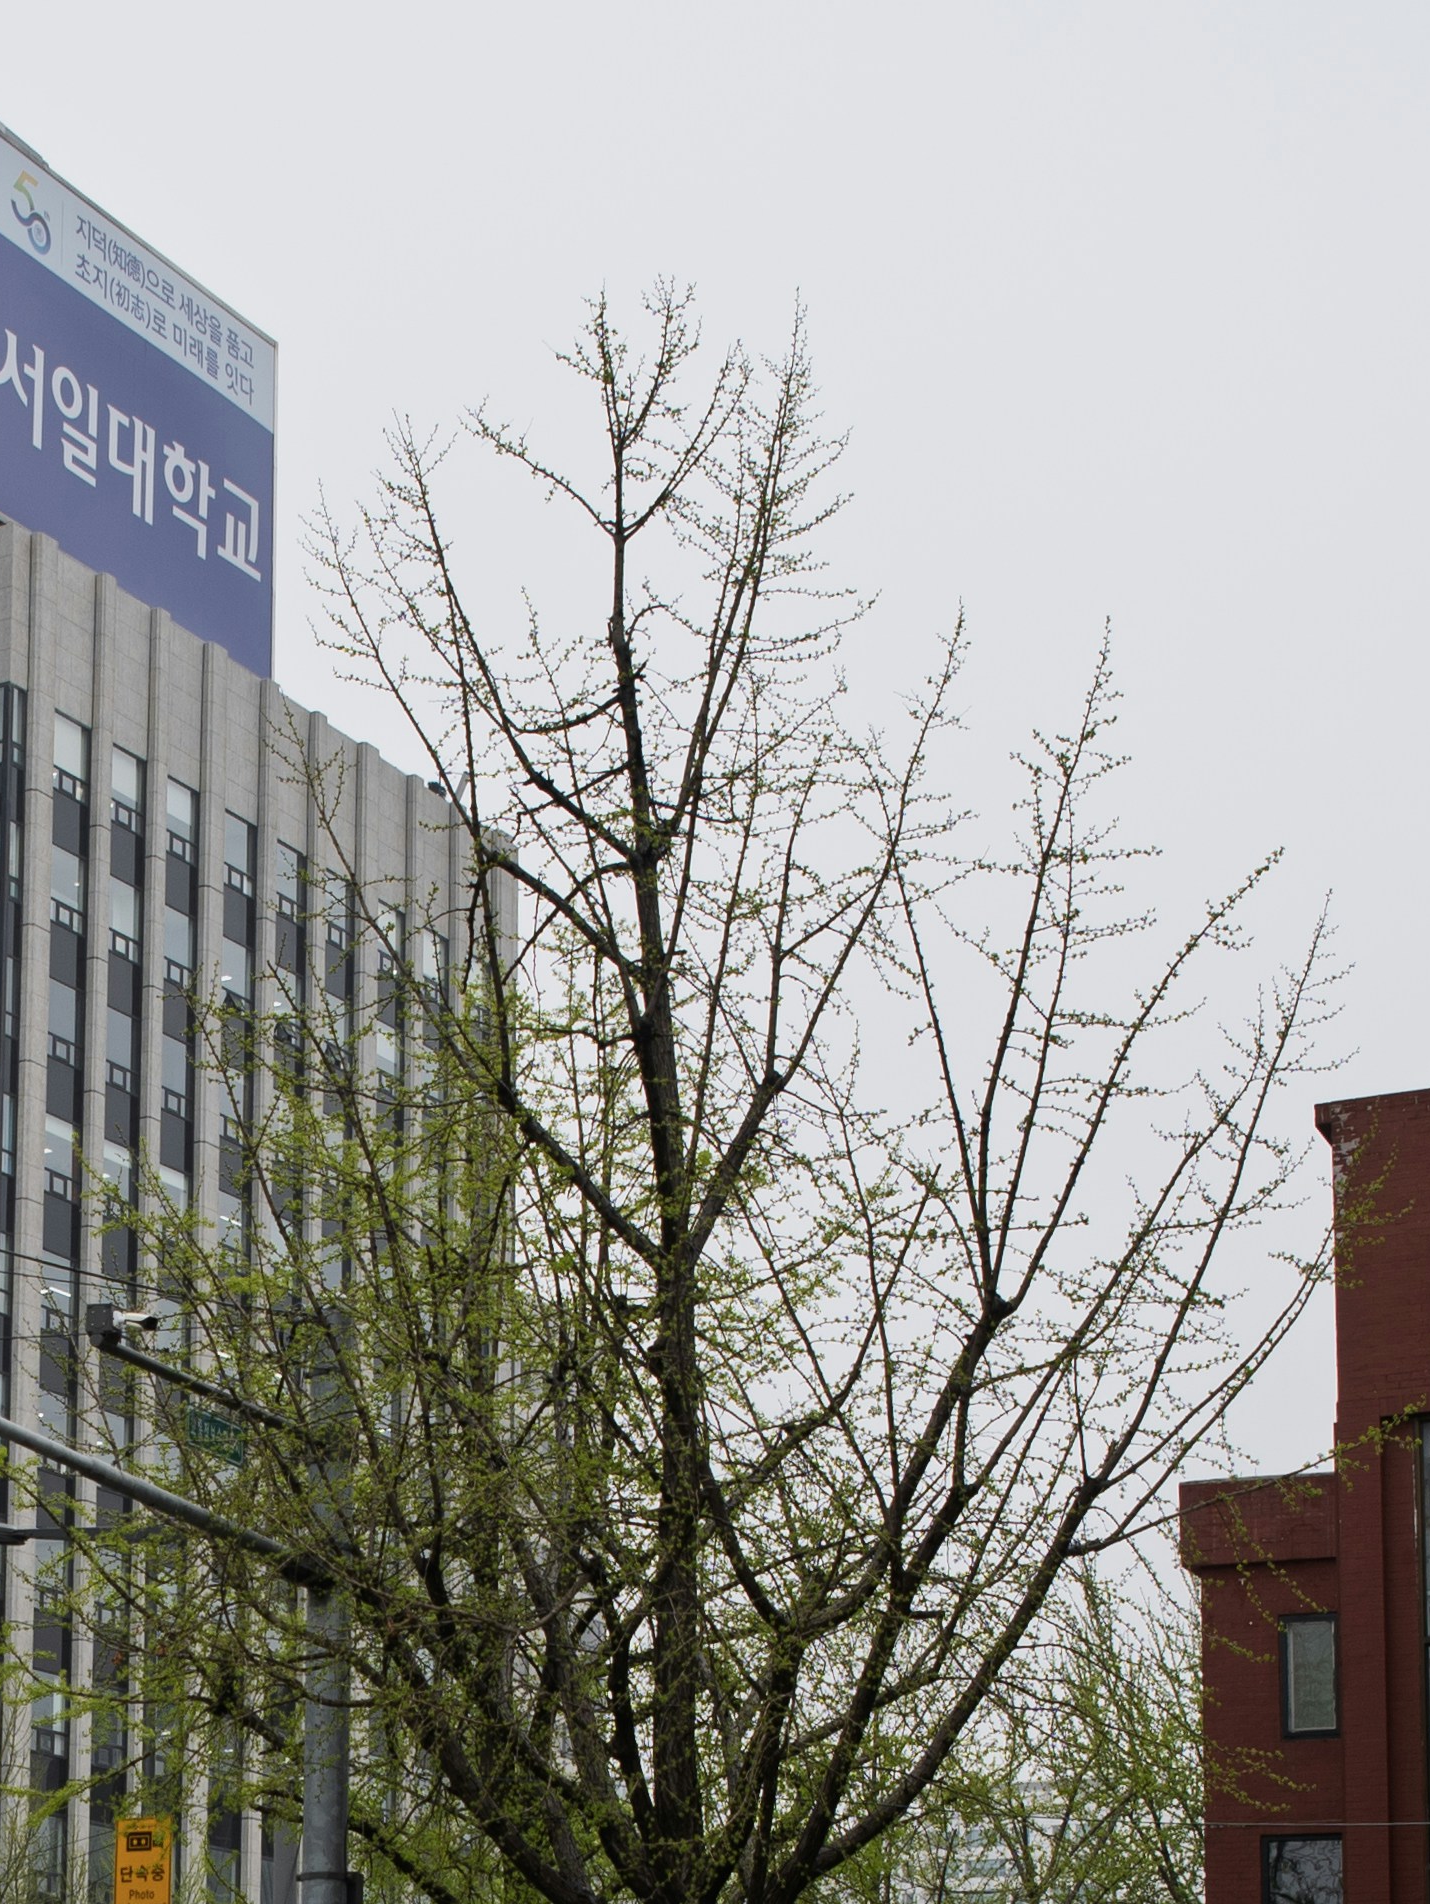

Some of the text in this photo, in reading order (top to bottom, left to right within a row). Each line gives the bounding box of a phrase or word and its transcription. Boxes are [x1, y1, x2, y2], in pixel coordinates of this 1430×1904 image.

[75, 253, 255, 406] 초지(初志)로 미래를 잇다
[76, 214, 255, 369] 지덕(知德)으로 세상을 품고
[119, 1864, 166, 1883] 단속중
[128, 1888, 155, 1901] Photo
